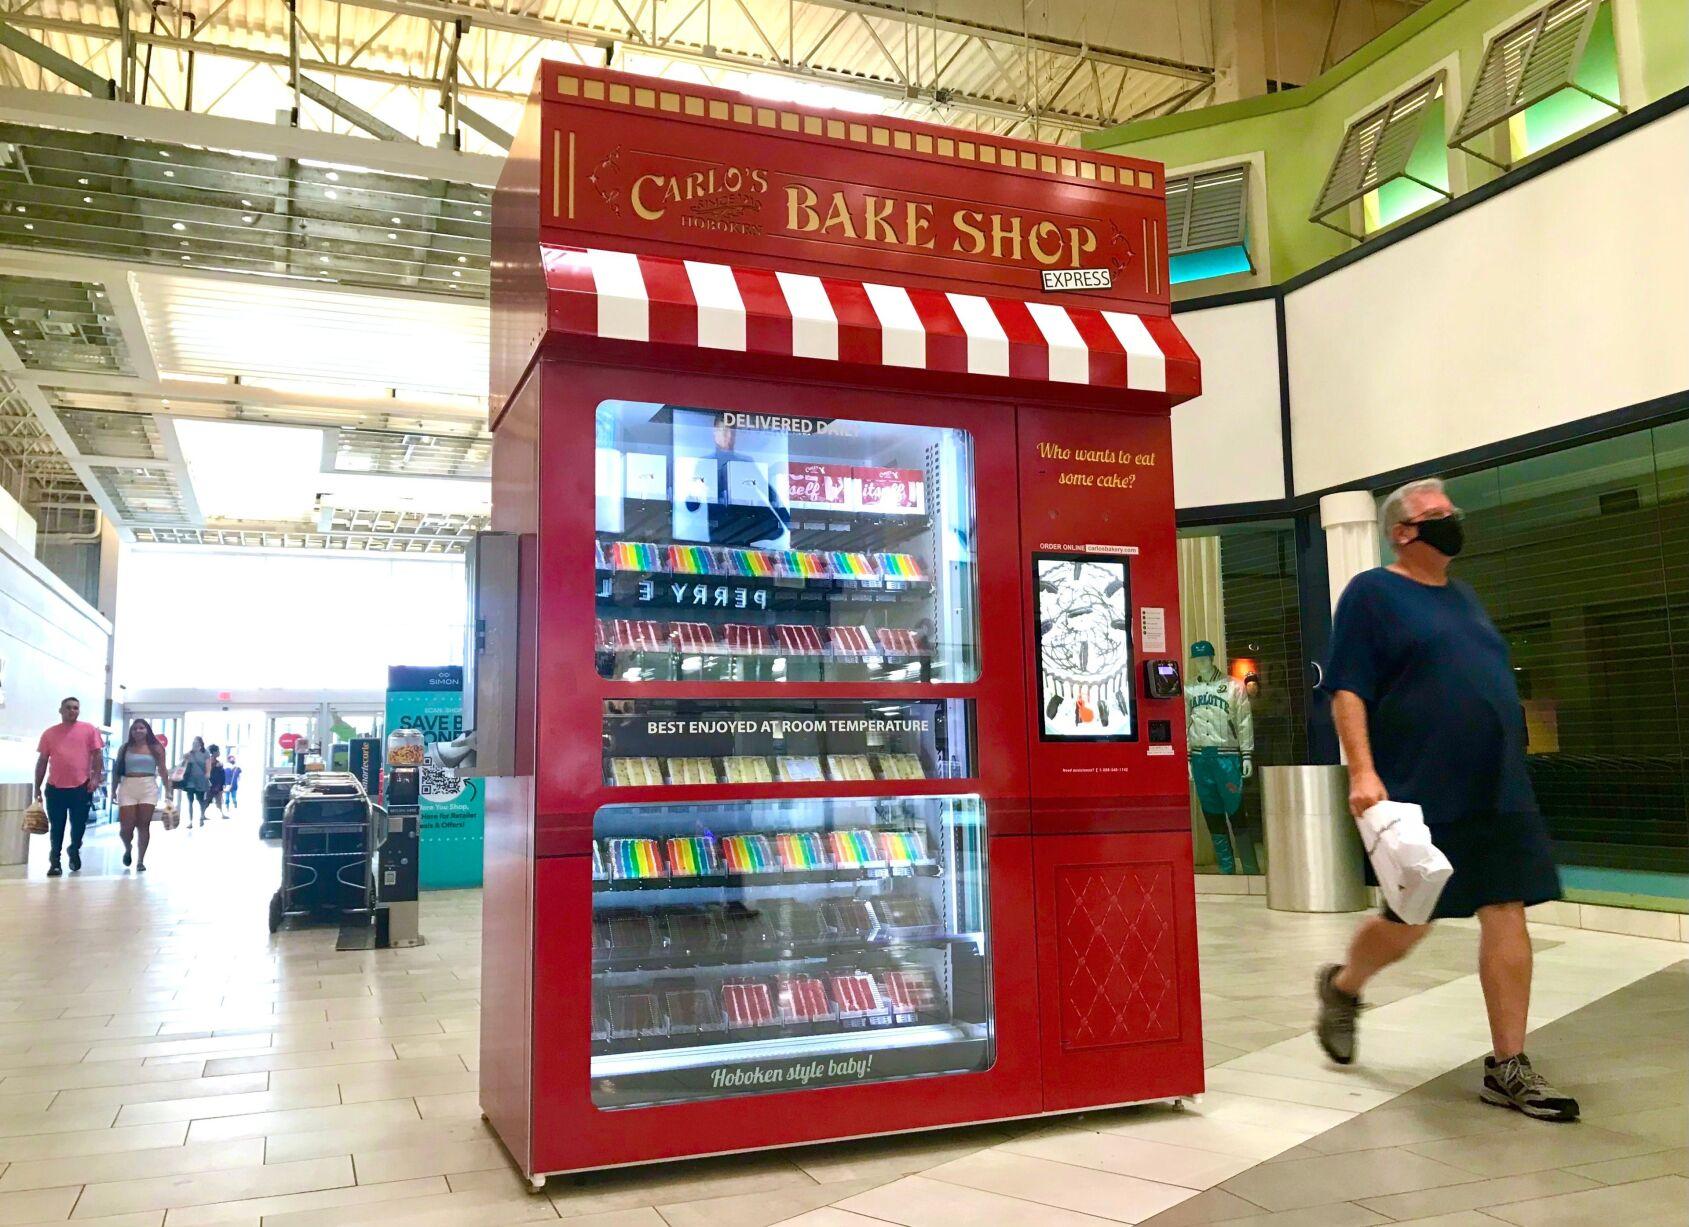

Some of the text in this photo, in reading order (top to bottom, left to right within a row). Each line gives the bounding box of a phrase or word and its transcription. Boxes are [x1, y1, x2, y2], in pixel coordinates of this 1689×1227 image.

[631, 167, 1098, 267] CARLO'S BAKE SHOP
[681, 215, 764, 236] HOBOKEN
[1043, 270, 1111, 289] EXPRESS
[723, 412, 813, 434] DELIVERED
[1036, 442, 1156, 466] Who wants to eat
[1058, 472, 1136, 489] some cake?
[1039, 542, 1062, 551] ORDER
[1063, 543, 1086, 552] ONLINE
[399, 714, 449, 730] SAVE
[647, 719, 929, 734] BEST ENJOYED AT ROOM TEMPERATURE
[711, 1054, 873, 1089] Hoboken style baby!
